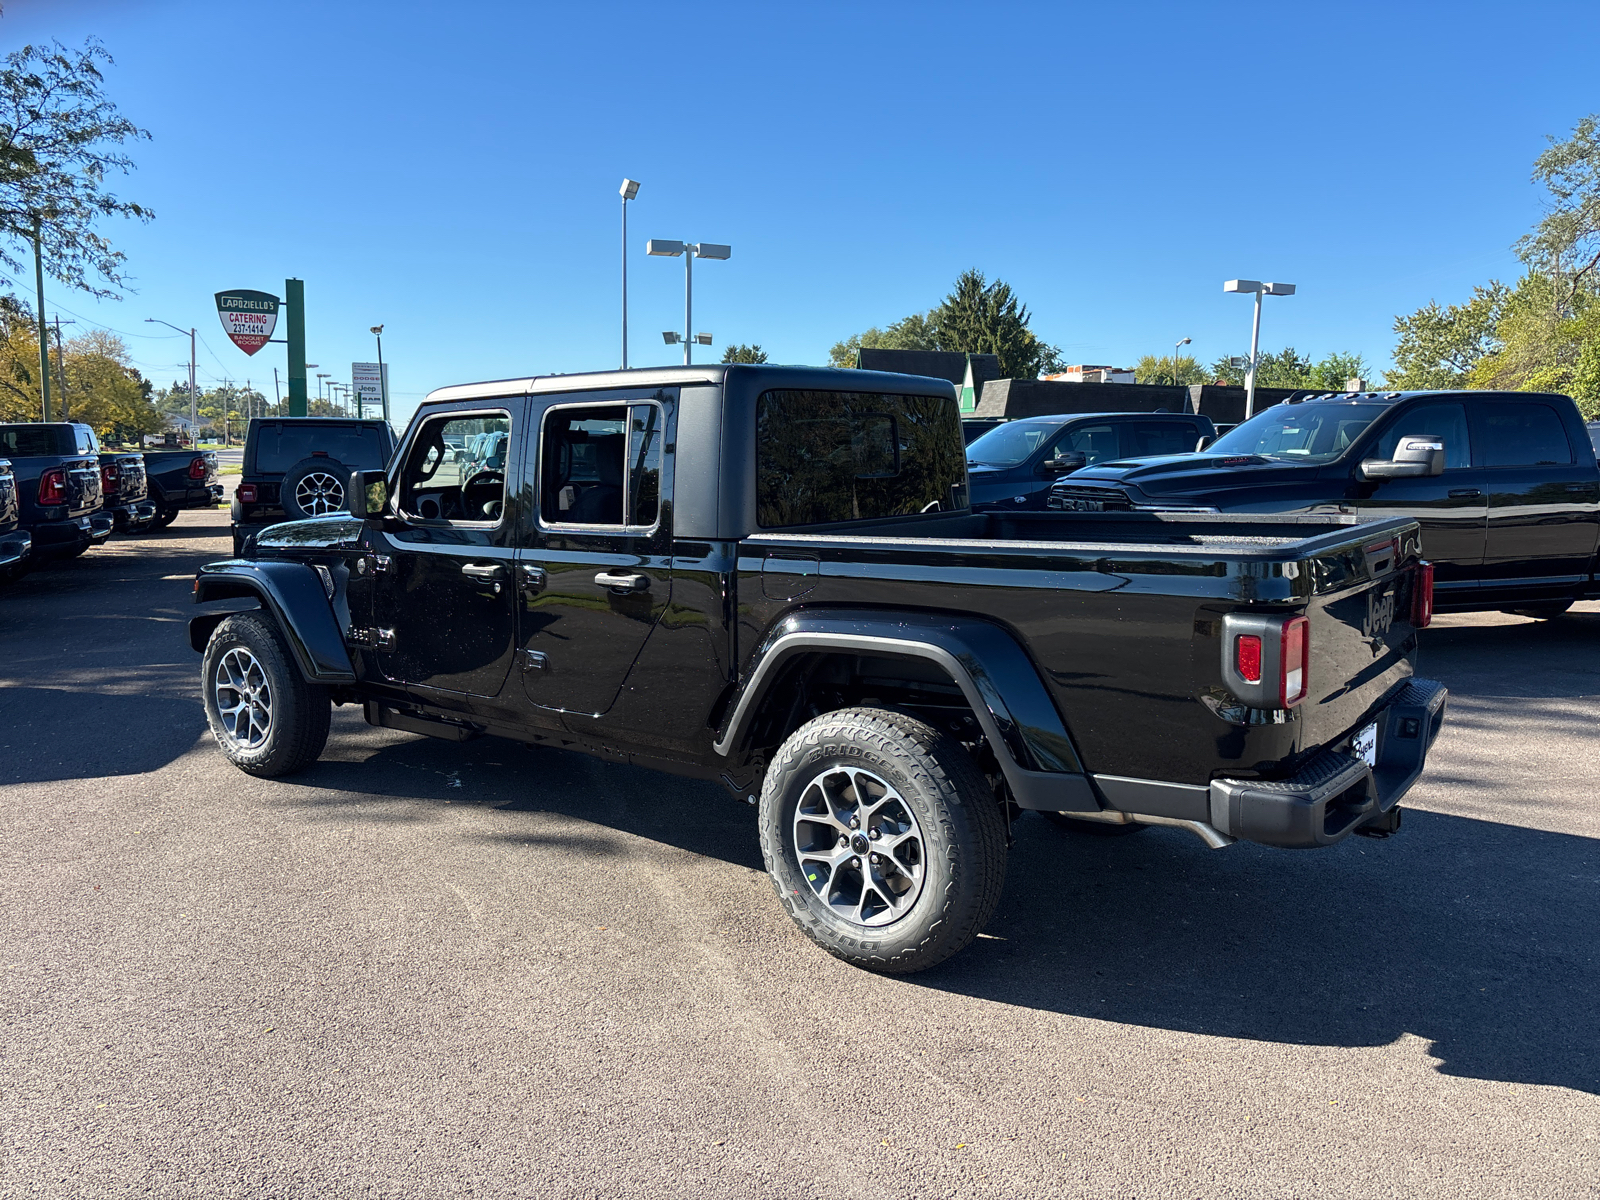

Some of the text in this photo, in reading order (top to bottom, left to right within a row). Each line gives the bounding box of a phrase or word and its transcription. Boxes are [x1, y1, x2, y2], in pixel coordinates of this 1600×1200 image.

[221, 296, 274, 310] CAPOZIELLO'S
[229, 313, 267, 324] CATERING
[233, 323, 264, 334] 237-1414
[1062, 498, 1104, 512] RAM
[1362, 593, 1394, 637] Jeep
[808, 744, 940, 848] BRIDGESTONE
